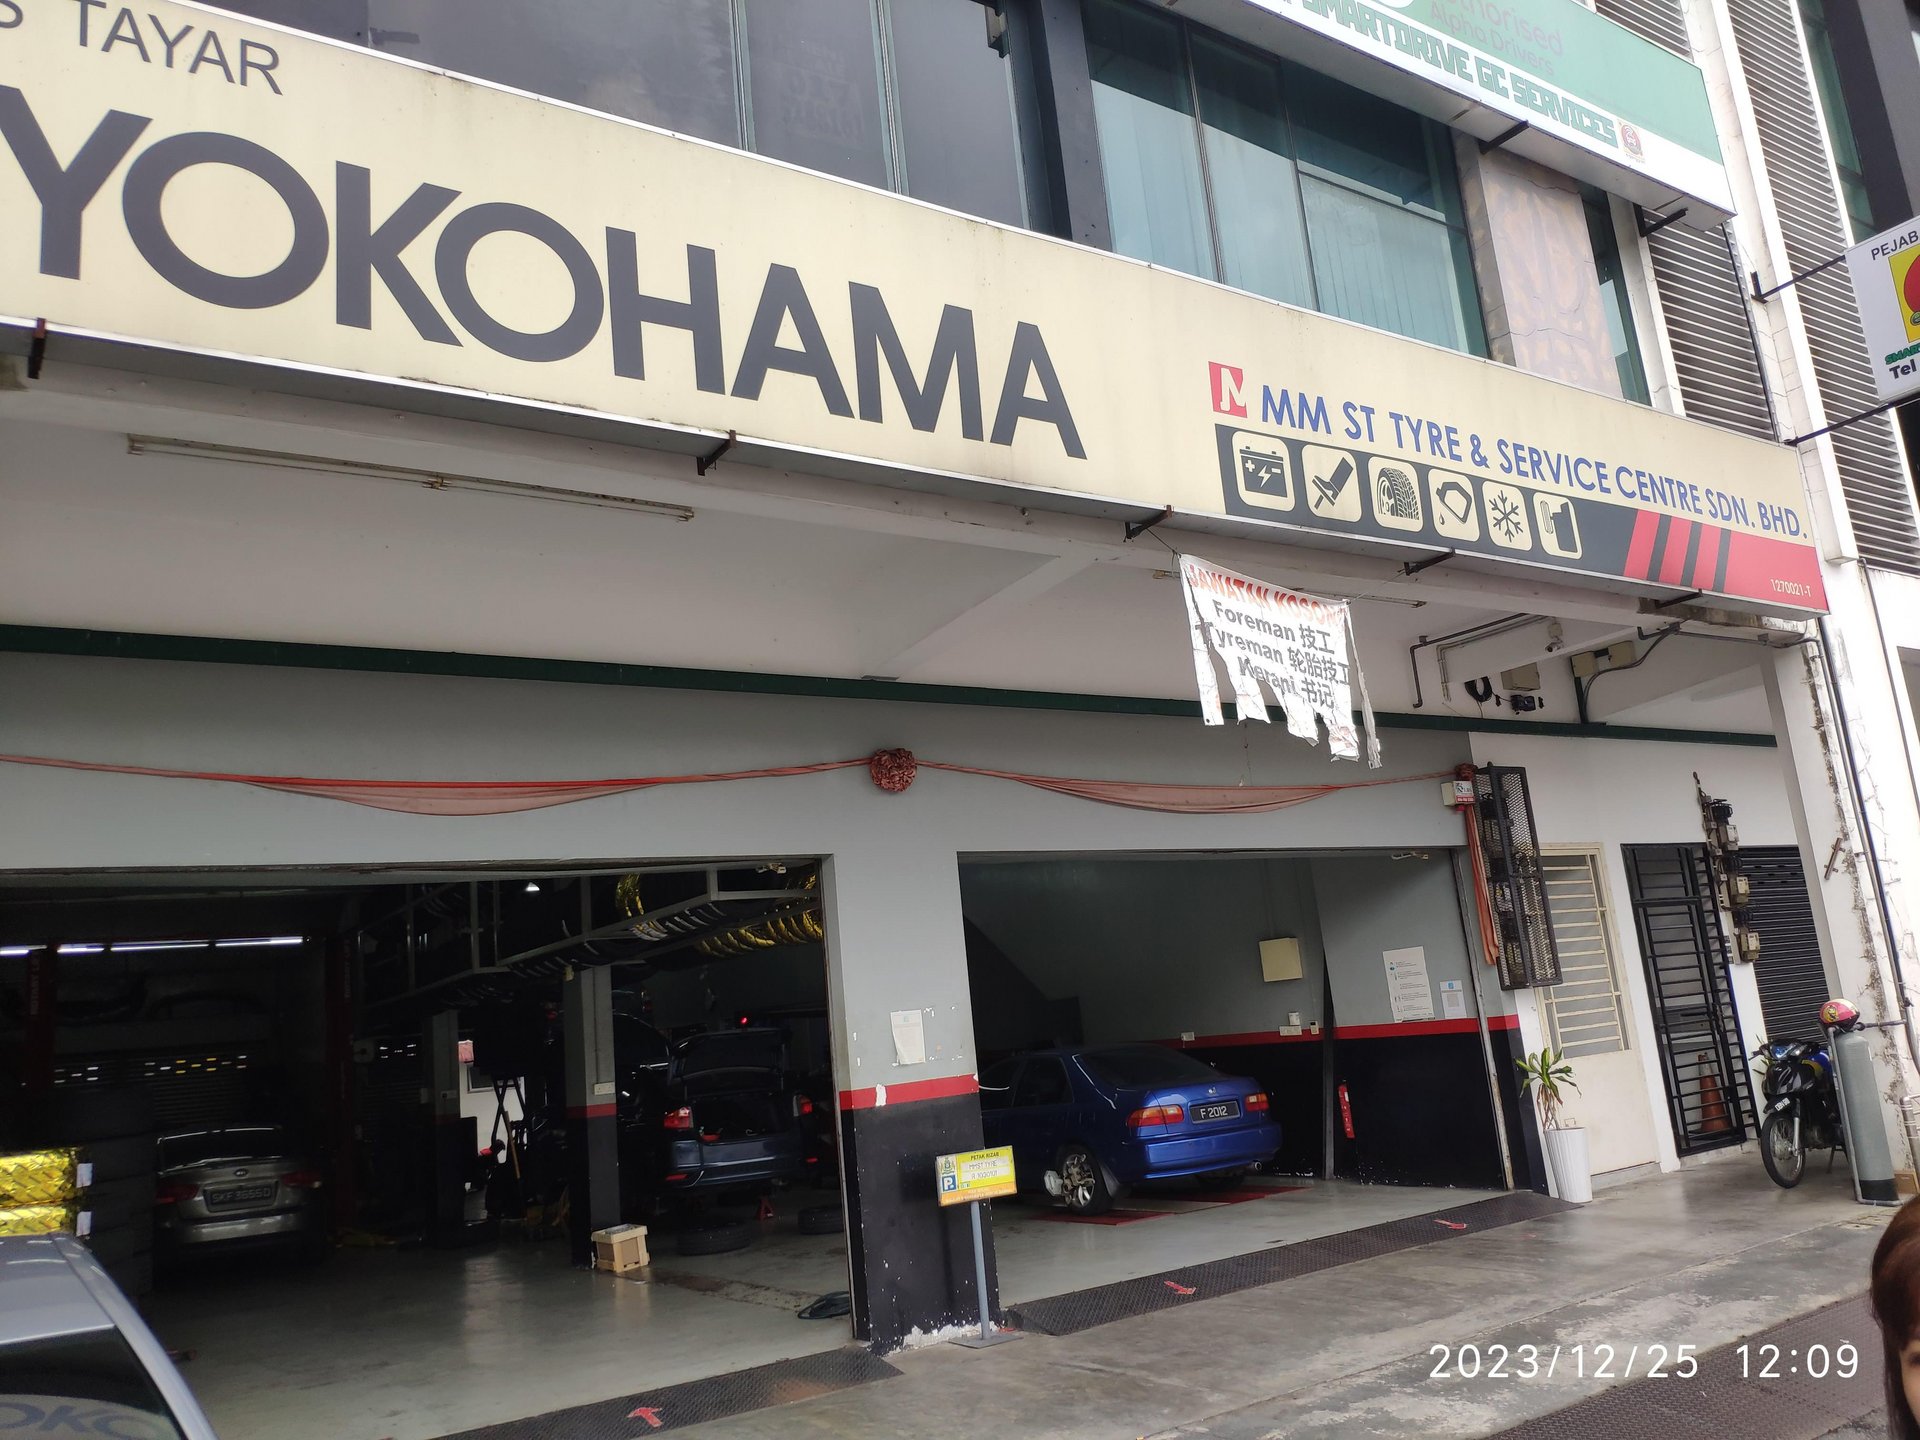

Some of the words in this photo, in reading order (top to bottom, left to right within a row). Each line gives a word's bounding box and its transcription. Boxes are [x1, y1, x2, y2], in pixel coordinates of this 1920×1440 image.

[72, 0, 283, 95] TAYAR
[1490, 29, 1555, 76] Drivers
[1474, 56, 1510, 99] GC
[1509, 72, 1618, 148] SERVICES
[1871, 231, 1919, 260] PEJAB
[0, 85, 1088, 460] YOKOHAMA
[1889, 359, 1917, 380] Tel
[1261, 385, 1332, 435] MM
[1342, 401, 1375, 443] ST
[1389, 411, 1462, 462] TYRE
[1470, 433, 1490, 468] &
[1497, 438, 1612, 495] SERVICE
[1615, 466, 1703, 516] CENTRE
[1705, 489, 1756, 528] SDN.
[1757, 501, 1808, 540] BHD.
[1188, 564, 1272, 611] JAWATAN
[1769, 578, 1812, 598] 1270021-T
[1212, 599, 1296, 643] Foreman
[1299, 623, 1335, 654] 技工
[1195, 621, 1285, 666] Tyreman
[1237, 655, 1297, 698] Kerani
[1287, 646, 1350, 686] 轮胎技工
[1300, 678, 1335, 709] 书记
[1200, 1108, 1207, 1119] F
[1208, 1105, 1228, 1118] 2012
